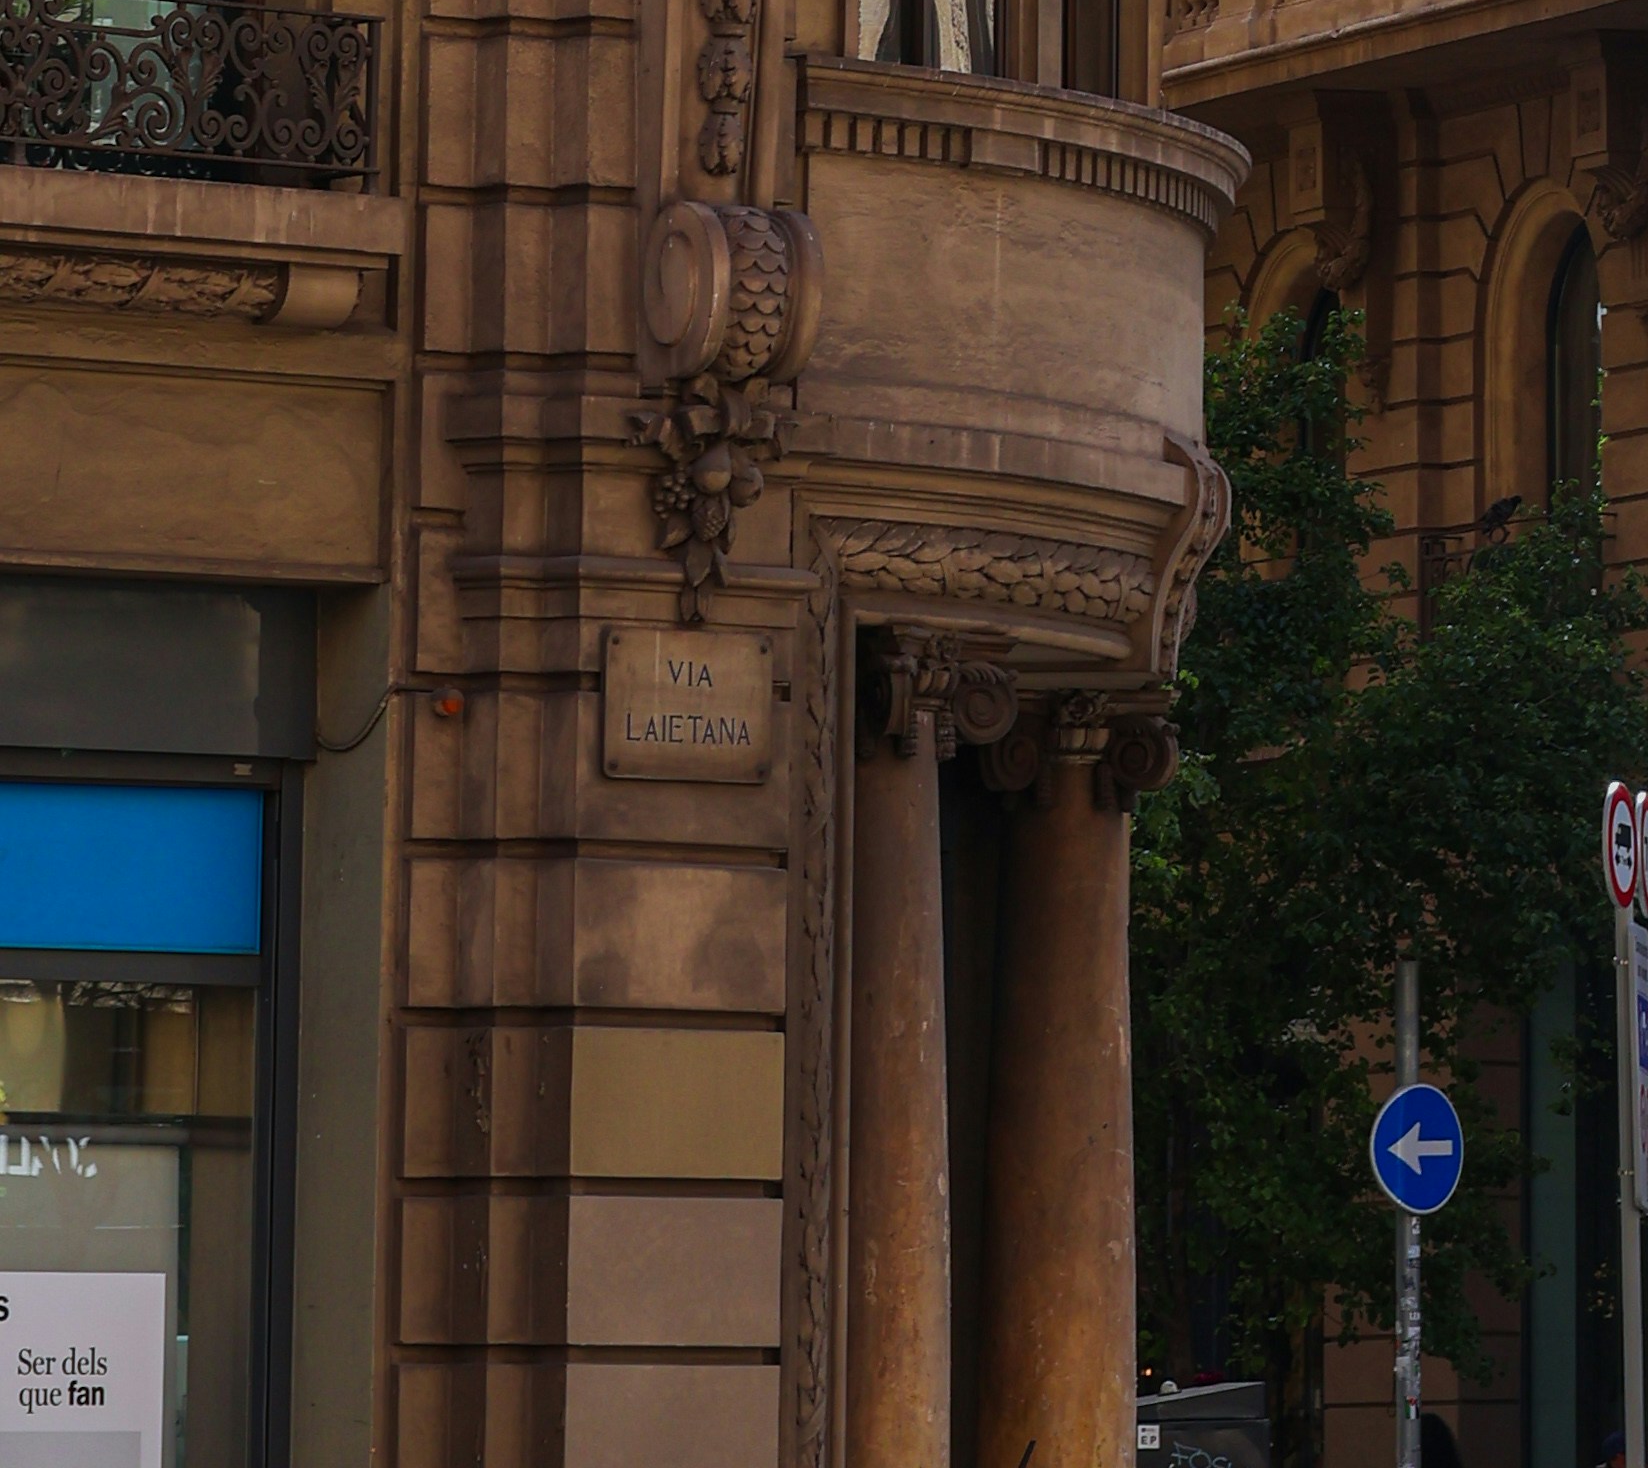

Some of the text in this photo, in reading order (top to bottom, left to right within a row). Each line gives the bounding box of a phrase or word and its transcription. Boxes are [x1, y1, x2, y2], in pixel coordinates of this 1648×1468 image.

[668, 660, 713, 688] VIA
[626, 712, 751, 746] LAIETANA
[17, 1347, 108, 1376] Ser dels
[19, 1380, 105, 1414] que fan
